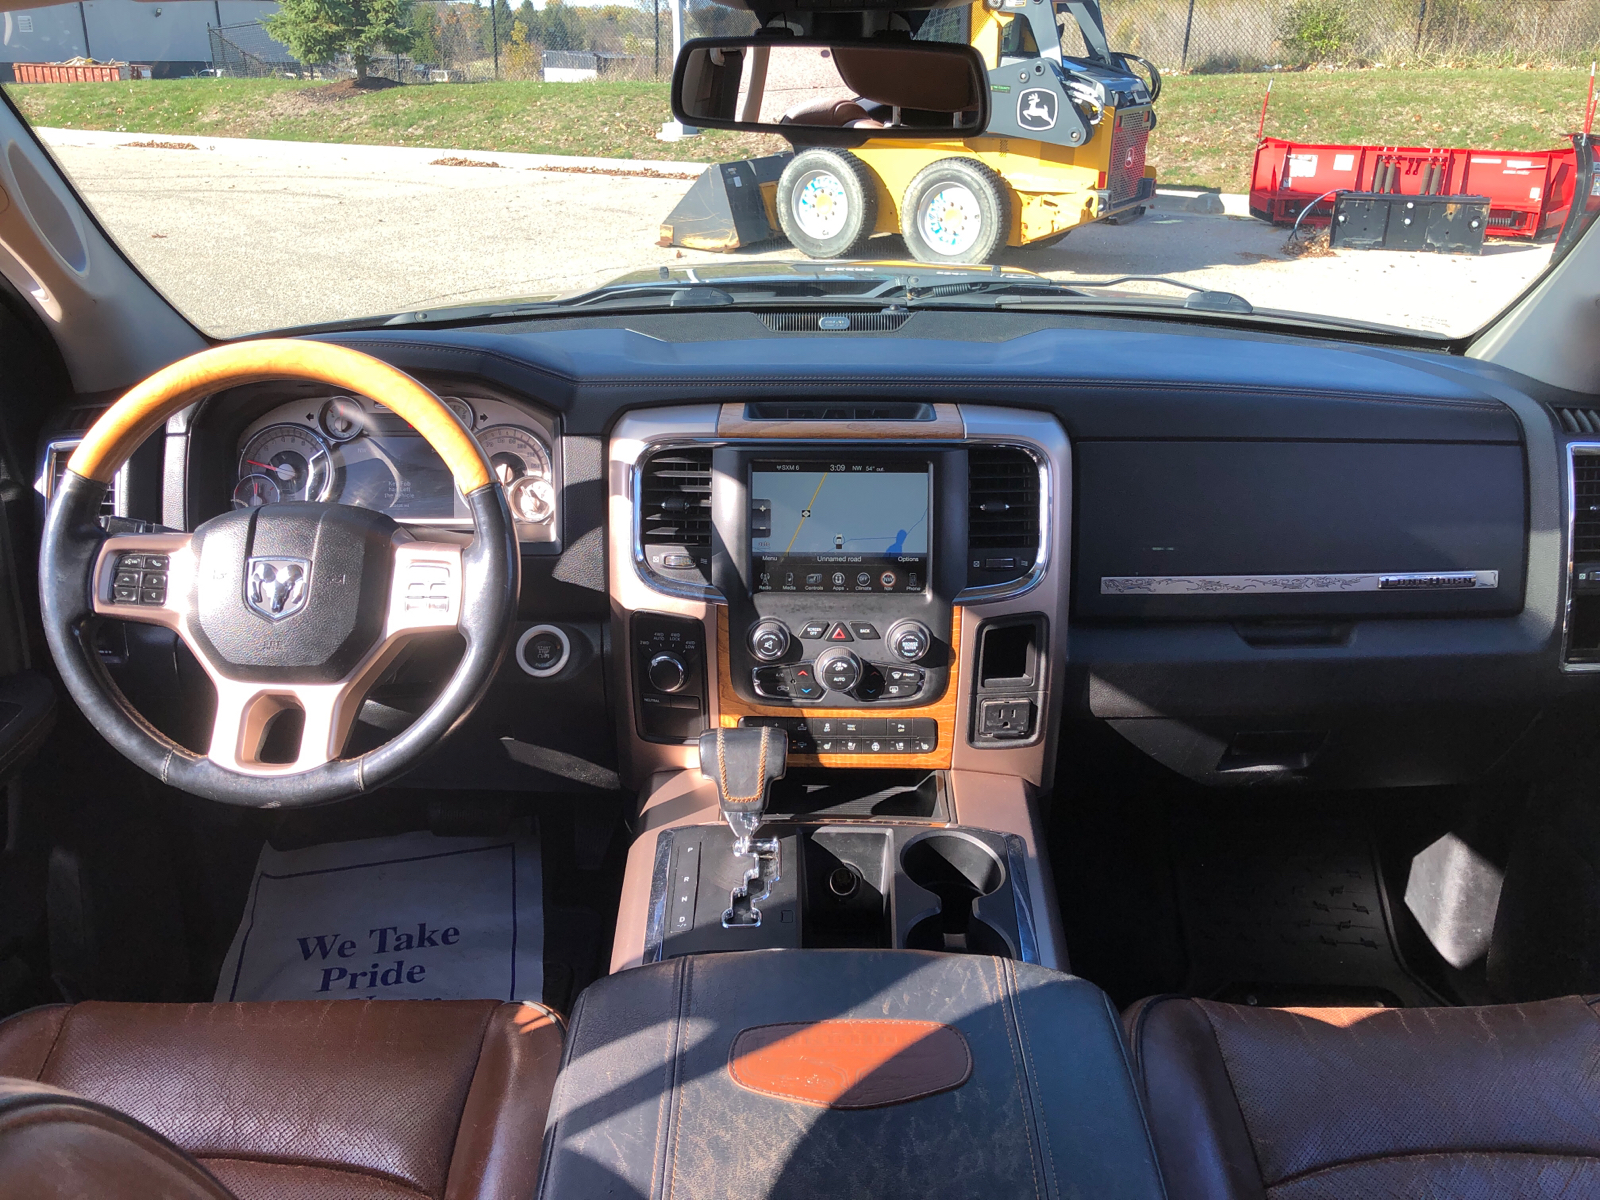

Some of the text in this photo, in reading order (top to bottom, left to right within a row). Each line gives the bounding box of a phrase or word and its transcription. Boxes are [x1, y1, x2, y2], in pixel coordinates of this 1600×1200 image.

[829, 464, 846, 472] 3:09
[296, 922, 461, 962] We Take
[315, 960, 427, 993] Pride
